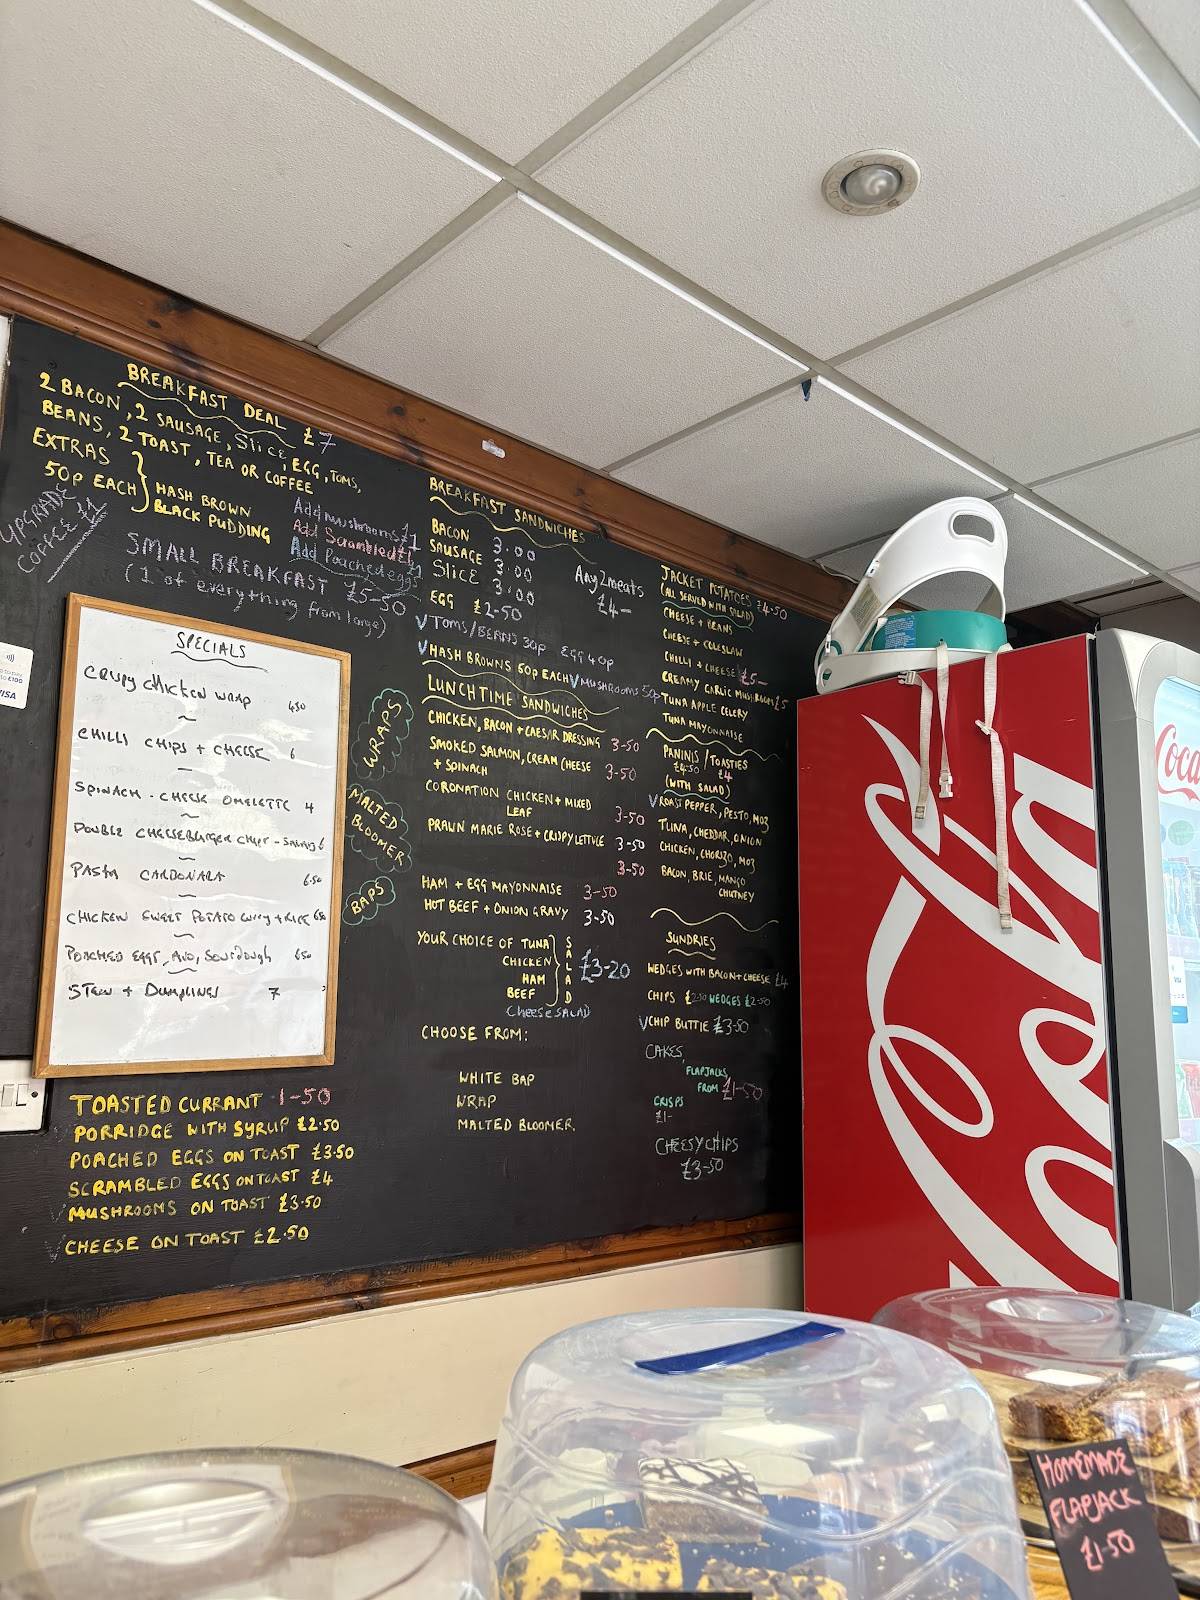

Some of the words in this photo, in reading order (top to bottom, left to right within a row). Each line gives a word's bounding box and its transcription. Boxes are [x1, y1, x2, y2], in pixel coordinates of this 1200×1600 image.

[39, 372, 56, 392] 2
[127, 363, 228, 410] BREAKFAST
[244, 403, 286, 430] DEAL
[303, 427, 336, 454] £7
[32, 426, 110, 465] EXTRAS
[119, 425, 133, 442] 2
[207, 451, 234, 470] TEA
[241, 463, 259, 480] OR
[265, 470, 314, 494] COFFEE
[93, 473, 137, 497] EACH
[155, 482, 193, 501] HASH
[201, 494, 251, 517] BROWN
[429, 476, 507, 515] BREAKFAST
[514, 508, 586, 544] SANDWICHES
[154, 498, 201, 522] BLACK
[209, 514, 271, 544] PUDDING
[431, 517, 470, 542] BACON
[126, 532, 199, 564] SMALL
[211, 552, 328, 595] BREAKFAST
[429, 538, 482, 565] SAUSAGE
[660, 564, 703, 590] JACKET
[709, 582, 752, 607] POTATOES
[197, 578, 298, 621] everything
[308, 601, 341, 621] from
[430, 590, 454, 610] EGG
[679, 590, 707, 608] SERVED
[708, 601, 727, 613] WITH
[663, 606, 695, 626] CHEESE
[707, 619, 734, 636] BEANS
[176, 631, 246, 658] SPECIALS
[663, 628, 691, 646] CHEESE
[703, 639, 744, 657] COLESLAW
[429, 643, 462, 662] HASH
[467, 651, 511, 673] BROWNS
[542, 668, 569, 684] EACH
[664, 650, 692, 668] CHILLI
[705, 663, 736, 678] CHEESE
[661, 670, 700, 691] CREAMY
[521, 695, 589, 721] SANDWICHES
[660, 692, 688, 708] TUNA
[691, 700, 717, 713] APPLE
[720, 706, 748, 721] CELERY
[363, 698, 402, 769] WRAPS
[483, 717, 513, 733] BACON
[525, 725, 560, 742] CAESAR
[562, 730, 601, 749] DRESSING
[662, 712, 686, 726] TUNA
[688, 719, 744, 743] MAYONNAISE
[429, 735, 476, 754] SMOKED
[526, 751, 558, 766] CREAM
[560, 756, 591, 773] CHEESE
[663, 744, 699, 764] PANINIS
[445, 758, 488, 777] SPINACH
[425, 779, 500, 798] CORONATION
[506, 789, 553, 805] CHICKEN
[564, 797, 592, 811] MIXED
[659, 796, 682, 808] ROAST
[305, 803, 314, 814] 4
[348, 788, 398, 830] MALTED
[506, 804, 533, 818] LEAF
[352, 813, 405, 866] BLOOMER
[428, 817, 465, 833] PRAWN
[470, 823, 503, 836] MARIE
[508, 823, 532, 837] ROSE
[543, 828, 573, 847] CRISPY
[575, 834, 605, 848] LETTUCE
[734, 833, 763, 847] ONION
[421, 875, 448, 890] HAM
[467, 877, 488, 894] EGG
[491, 880, 563, 896] MAYONNAISE
[718, 874, 746, 889] MANGO
[351, 882, 384, 915] BAPS
[718, 888, 755, 903] CHUTNEY
[424, 898, 446, 911] HOT
[448, 900, 479, 914] BEEF
[493, 903, 529, 917] ONION
[533, 905, 569, 921] GRAVY
[417, 930, 448, 946] YOUR
[452, 933, 494, 947] CHOICE
[499, 937, 513, 949] OF
[520, 938, 550, 950] TUNA
[665, 931, 716, 951] SUNDRIES
[502, 955, 552, 967] CHICKEN
[647, 962, 683, 977] WEDGES
[686, 967, 706, 977] WITH
[522, 973, 546, 985] HAM
[269, 987, 280, 1000] 7
[506, 987, 536, 1000] BEEF
[647, 989, 676, 1004] CHIPS
[709, 993, 741, 1007] WEDGES
[421, 1024, 478, 1042] CHOOSE
[485, 1025, 528, 1042] FROM:
[648, 1016, 670, 1028] CHIP
[675, 1017, 709, 1032] BUTTIE
[459, 1071, 502, 1085] WHITE
[511, 1073, 535, 1087] BAP
[697, 1082, 719, 1093] FROM
[69, 1094, 172, 1116] TOASTED
[178, 1093, 263, 1112] CURRANT
[456, 1094, 497, 1109] WRAP
[654, 1095, 684, 1108] CRISPS
[74, 1123, 173, 1143] PORRIDGE
[187, 1121, 227, 1136] WITH
[233, 1117, 289, 1139] SYRUP
[458, 1117, 512, 1132] MALTED
[69, 1151, 158, 1169] POACHED
[172, 1149, 214, 1166] EGGS
[223, 1149, 244, 1163] ON
[251, 1144, 300, 1161] TOAST
[69, 1177, 181, 1198] SCRAMBLED
[191, 1172, 231, 1191] EGGS
[236, 1174, 257, 1187] ON
[257, 1169, 300, 1184] TOAST
[311, 1169, 333, 1185] £4
[69, 1200, 176, 1222] MUSHROOMS
[191, 1201, 214, 1215] ON
[221, 1198, 266, 1211] TOAST
[65, 1235, 139, 1256] CHEESE
[151, 1235, 179, 1249] ON
[185, 1230, 245, 1246] TOAST
[1049, 1487, 1142, 1530] FLAPJACK
